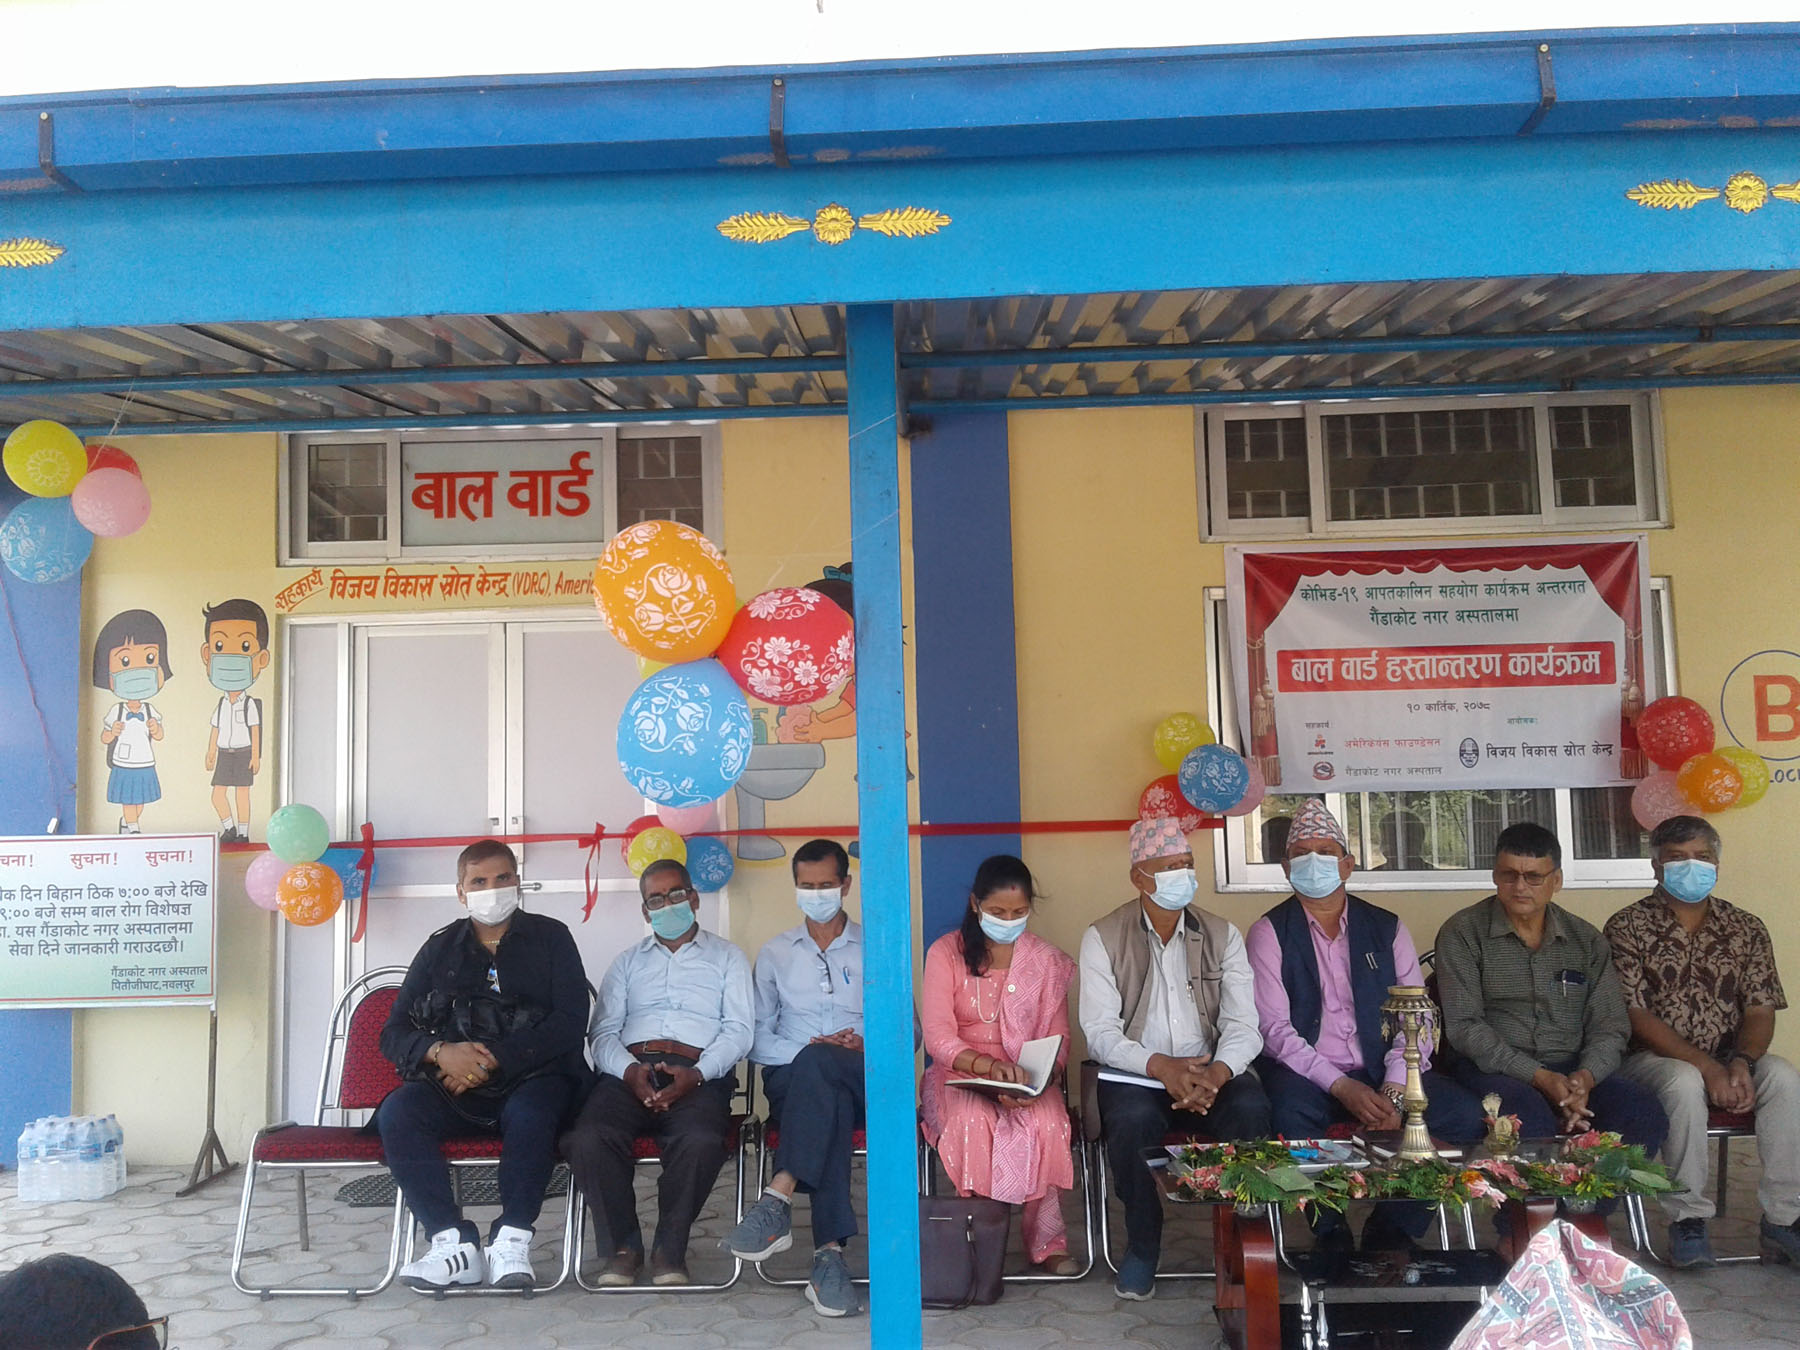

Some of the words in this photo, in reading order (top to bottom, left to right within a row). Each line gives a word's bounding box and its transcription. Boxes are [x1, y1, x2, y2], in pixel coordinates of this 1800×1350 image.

[412, 472, 499, 522] बाल
[507, 451, 594, 517] वार्ड
[329, 568, 380, 600] विजय
[383, 567, 438, 601] विकास
[476, 565, 512, 597] केन्द्र
[1300, 584, 1359, 602] कोभिड-१९
[1365, 581, 1432, 600] आपतकालिन
[1439, 580, 1478, 598] सहयोग
[1484, 578, 1530, 596] कार्यक्रम
[1537, 580, 1586, 594] अन्तरगत
[1369, 606, 1416, 626] गैंडाकोट
[1422, 610, 1449, 624] नगर
[1456, 608, 1519, 624] अस्पतालमा
[1291, 657, 1335, 683] बाल
[1341, 650, 1379, 681] वार्ड
[1386, 654, 1502, 682] हस्तान्तरण
[1508, 646, 1601, 677] कार्यक्रम
[1407, 703, 1420, 713] १०
[1464, 701, 1491, 711] २०७८
[1486, 743, 1516, 758] विजय
[1522, 742, 1557, 757] विकास
[1592, 740, 1614, 757] केन्द्र
[1383, 767, 1401, 776] नगर
[20, 885, 42, 902] दिन
[47, 884, 83, 902] बिहान
[87, 883, 114, 900] ठिक
[119, 887, 150, 899] ७:००
[154, 881, 177, 898] बजे
[180, 880, 208, 897] देखि
[34, 903, 56, 919] बजे
[60, 907, 87, 918] सम्म
[91, 906, 117, 918] बाल
[120, 901, 141, 917] रोग
[146, 900, 192, 916] विशेषज्ञ
[15, 926, 36, 938] यस
[40, 920, 89, 938] गैंडाकोट
[93, 924, 119, 936] नगर
[124, 922, 193, 936] अस्पतालमा
[9, 940, 34, 956] सेवा
[38, 939, 60, 956] दिने
[64, 938, 119, 955] जानकारी
[148, 967, 166, 977] नगर
[169, 965, 208, 976] अस्पताल
